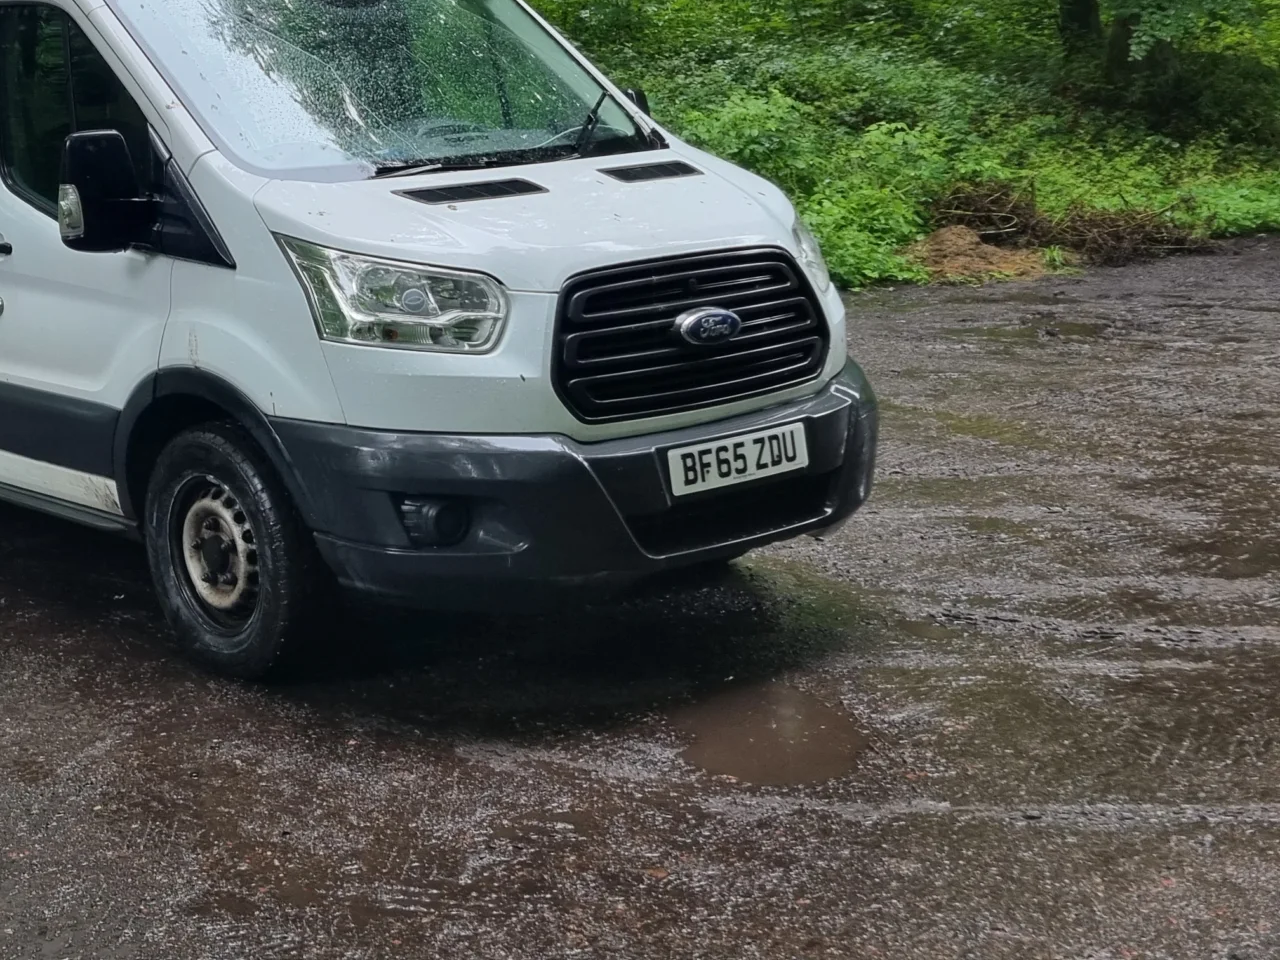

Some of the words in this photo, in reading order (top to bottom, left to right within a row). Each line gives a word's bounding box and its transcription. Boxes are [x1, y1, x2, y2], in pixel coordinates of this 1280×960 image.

[700, 316, 732, 339] Ford
[680, 441, 748, 486] BF65
[752, 430, 797, 471] ZDU
